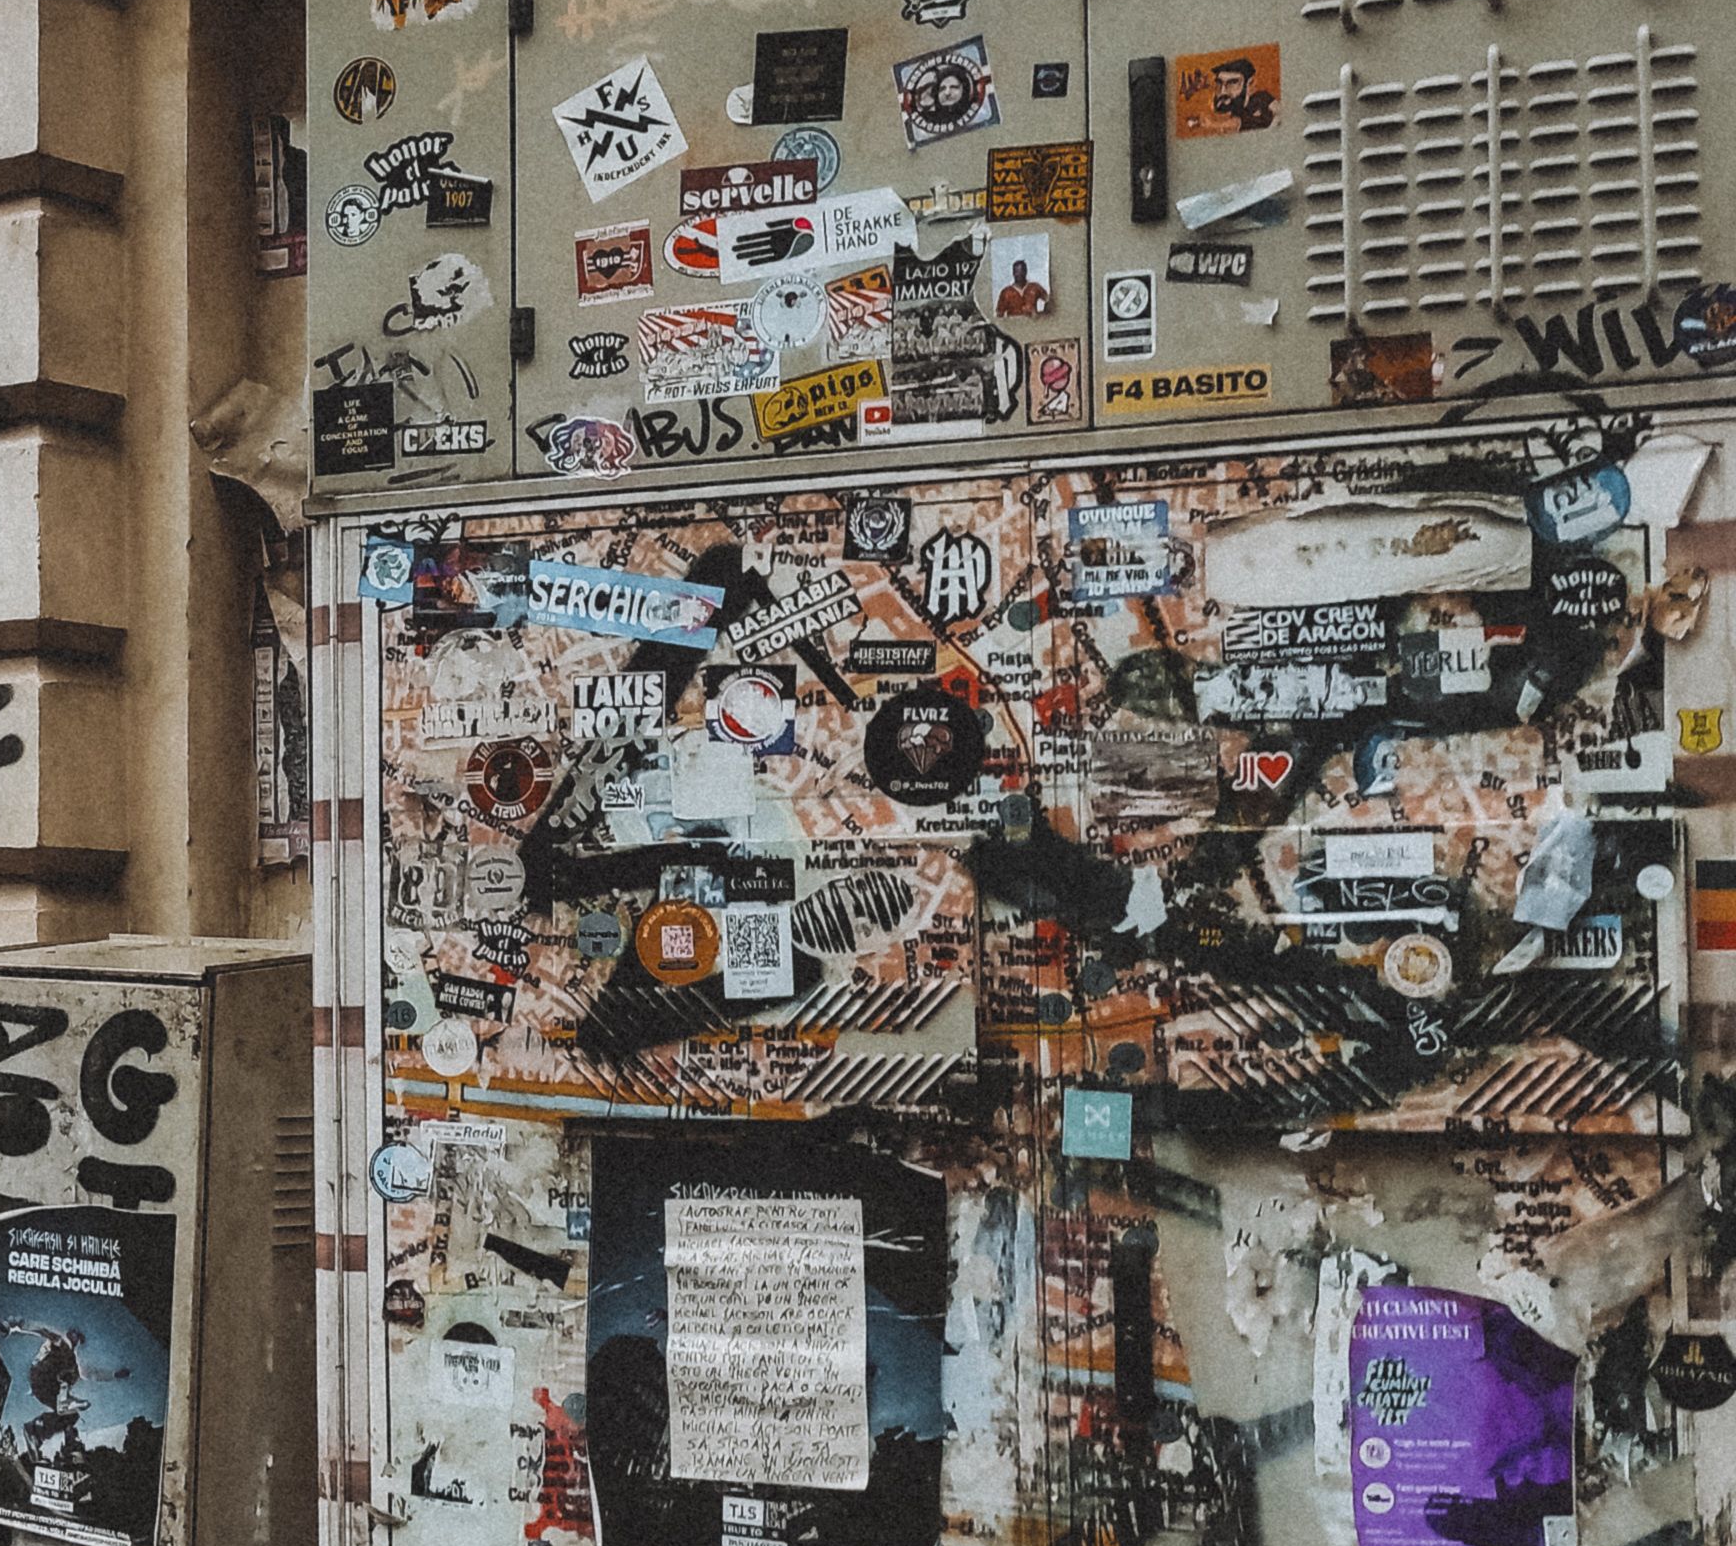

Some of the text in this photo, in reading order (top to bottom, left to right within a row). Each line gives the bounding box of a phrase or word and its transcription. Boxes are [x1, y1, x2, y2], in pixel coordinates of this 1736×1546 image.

[654, 132, 674, 158] INK
[445, 191, 473, 208] 1907
[833, 206, 853, 221] DE
[834, 211, 902, 236] STRAKKE
[835, 232, 879, 252] HAND
[595, 254, 621, 269] 1910
[905, 262, 949, 281] LAZIO
[1197, 253, 1247, 277] WPC
[1106, 368, 1268, 404] F4 BASITO
[344, 398, 362, 409] LIFE
[349, 407, 357, 416] IS
[344, 414, 368, 424] GAME
[347, 422, 359, 431] OF
[320, 427, 388, 442] CONCENTRATION
[344, 437, 363, 447] AND
[342, 445, 368, 455] FOCUS
[1078, 503, 1156, 525] OVUNQUE
[728, 572, 849, 641] BASARABIA
[1263, 604, 1378, 629] CDV CREW
[758, 599, 860, 658] ROMANIA
[1263, 620, 1386, 646] DE ARAGON
[574, 674, 664, 707] TAKIS
[574, 707, 664, 740] ROTZ
[8, 1251, 122, 1281] CARE SCHIMBĂ
[8, 1268, 125, 1300] REGULA JOCULUI.
[1432, 1323, 1472, 1341] FEST
